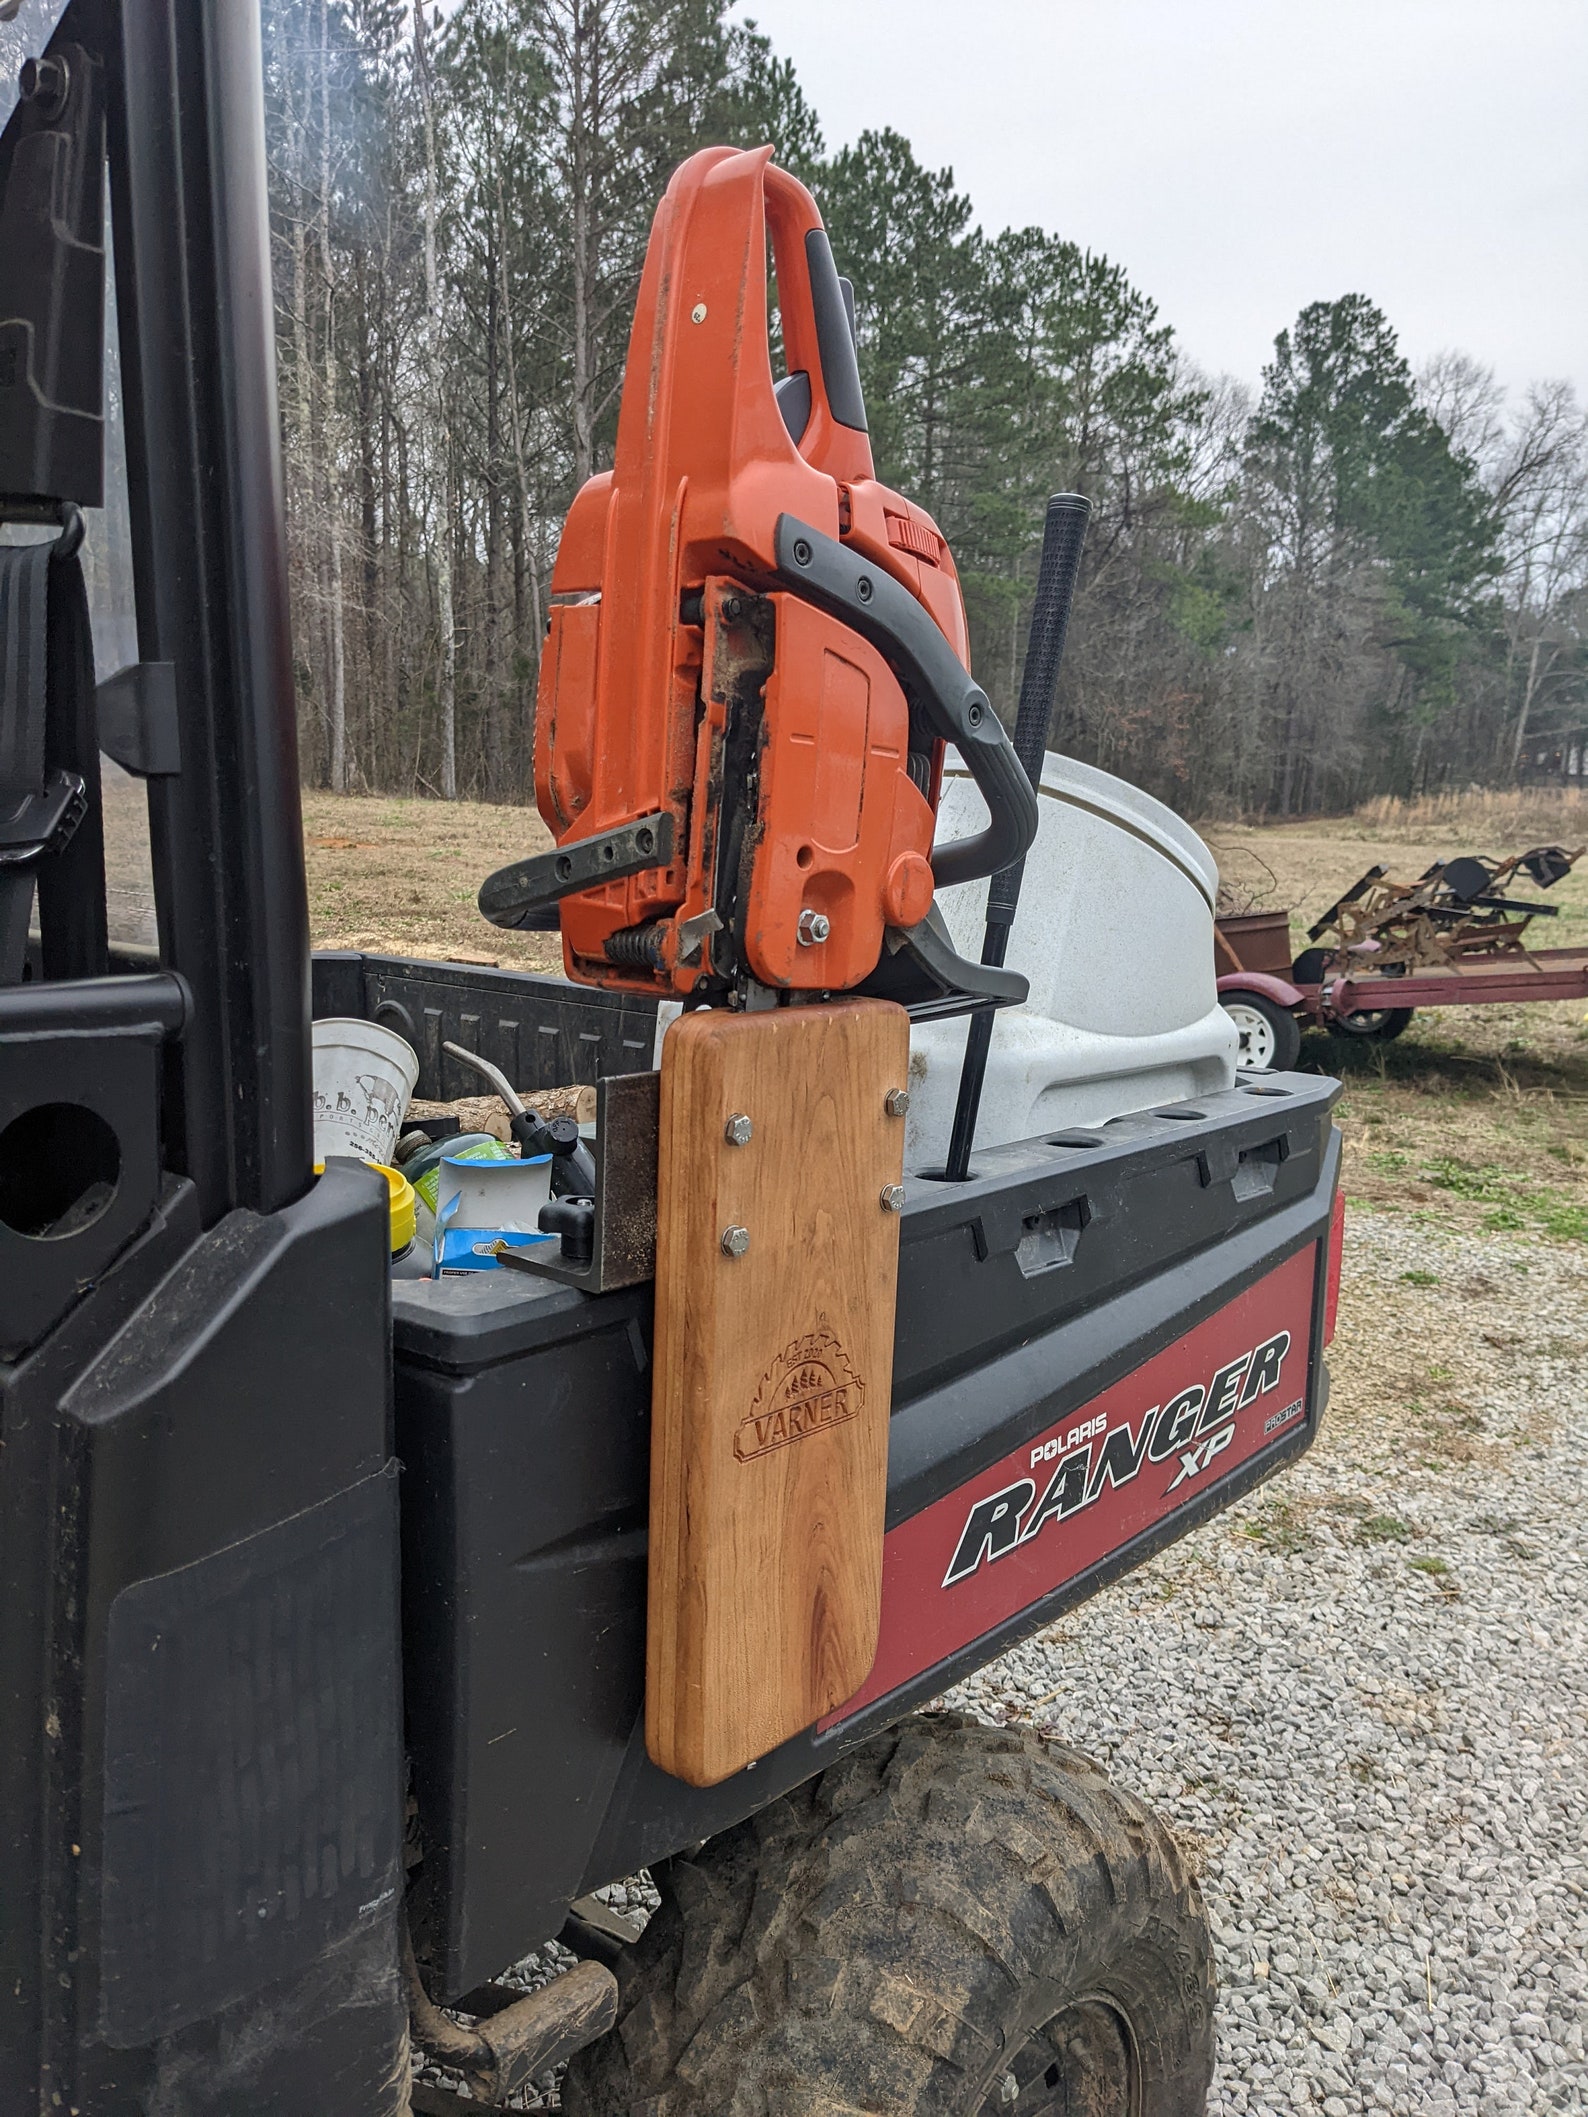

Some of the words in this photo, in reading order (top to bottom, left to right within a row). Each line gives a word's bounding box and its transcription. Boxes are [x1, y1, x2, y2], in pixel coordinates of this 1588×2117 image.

[754, 1387, 849, 1447] VARNER
[1030, 1411, 1107, 1469] POLARIS
[1264, 1398, 1303, 1434] PROSTAR
[941, 1330, 1291, 1590] RANGER
[1162, 1423, 1236, 1498] XP
